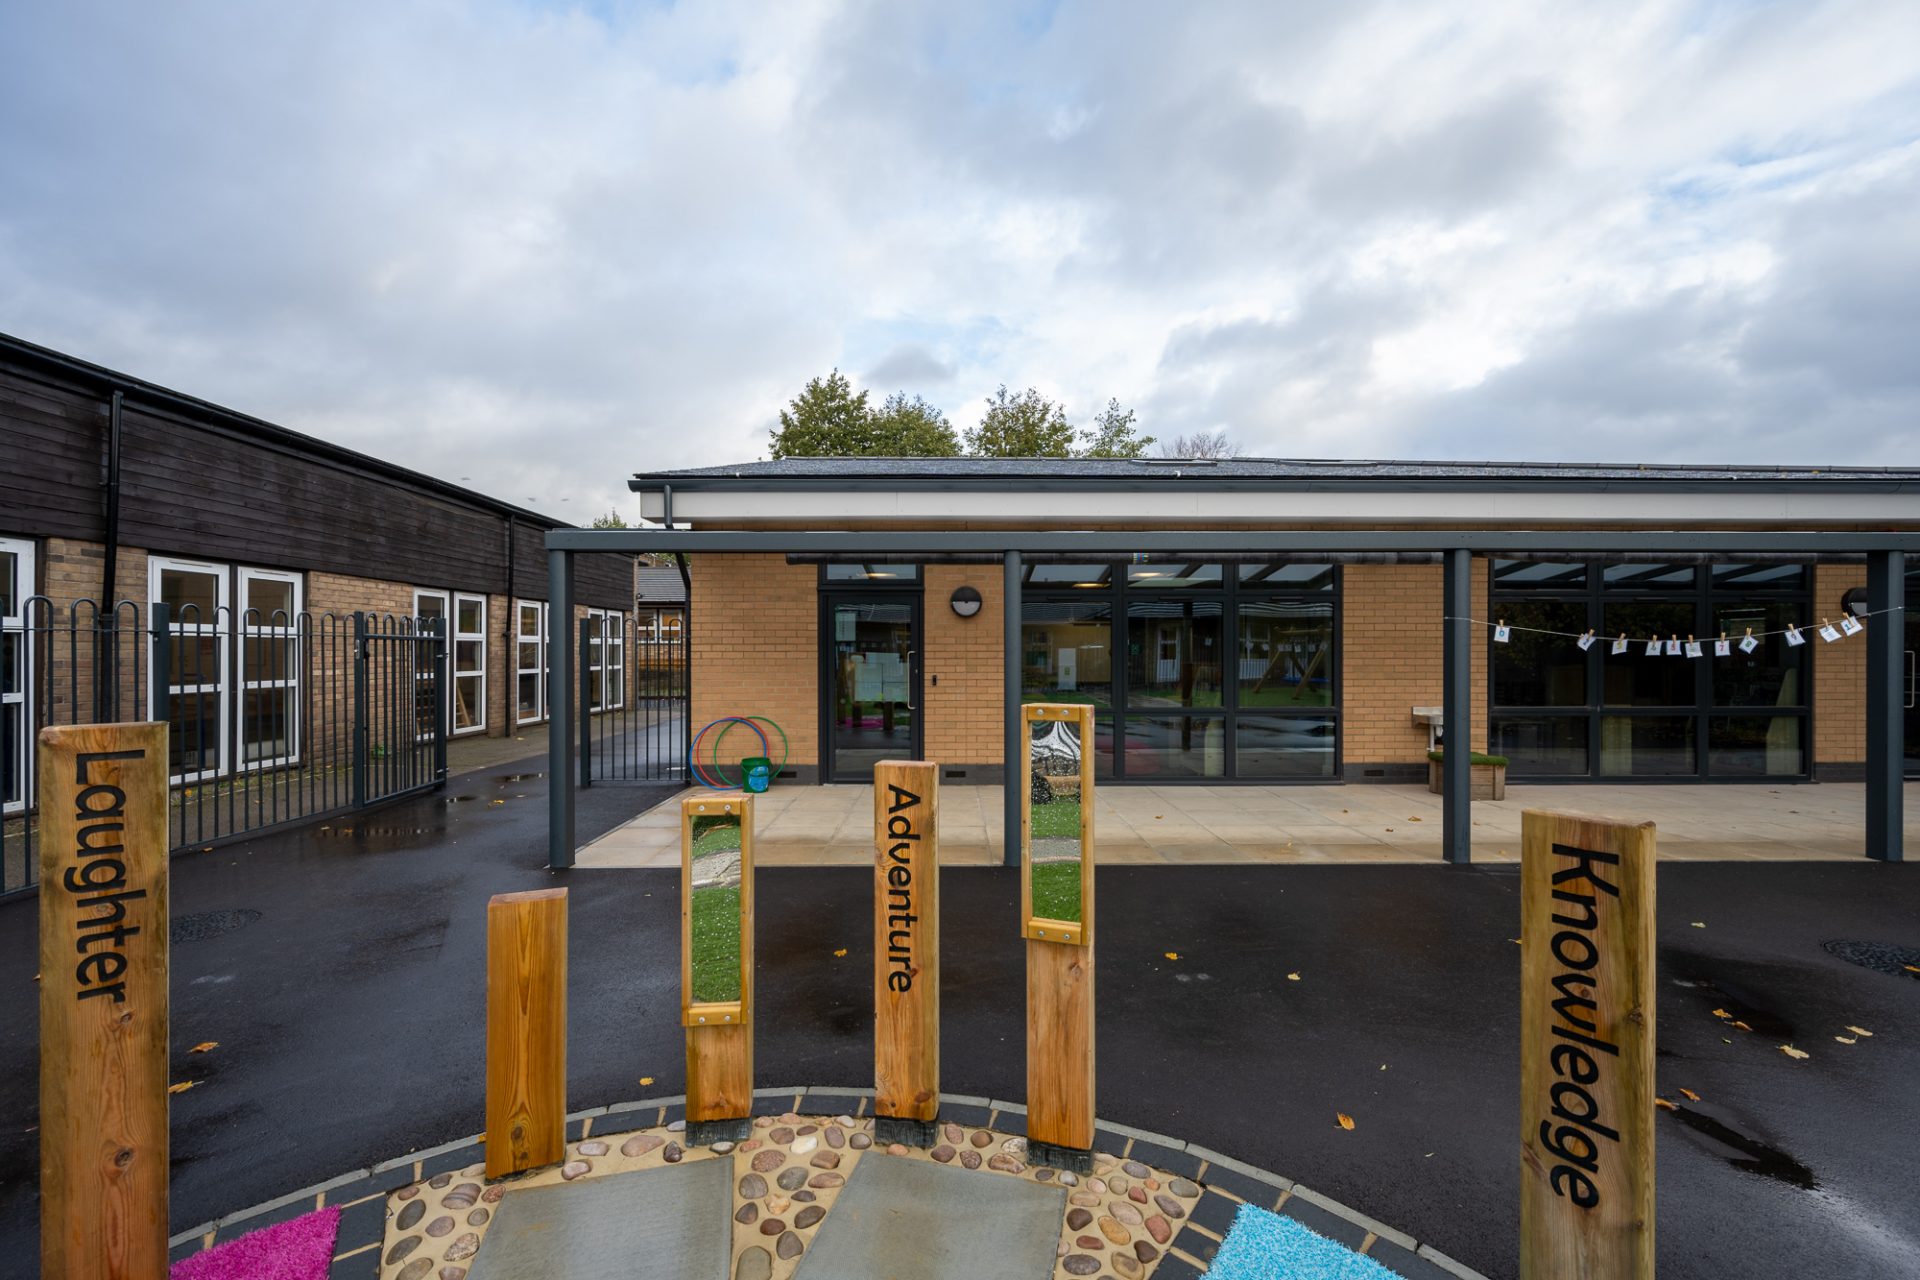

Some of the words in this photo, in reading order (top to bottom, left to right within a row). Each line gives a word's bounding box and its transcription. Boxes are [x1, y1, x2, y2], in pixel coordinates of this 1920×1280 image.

[63, 749, 146, 1003] Laughter
[888, 783, 921, 992] Adventure
[1540, 843, 1620, 1208] Knowledge
